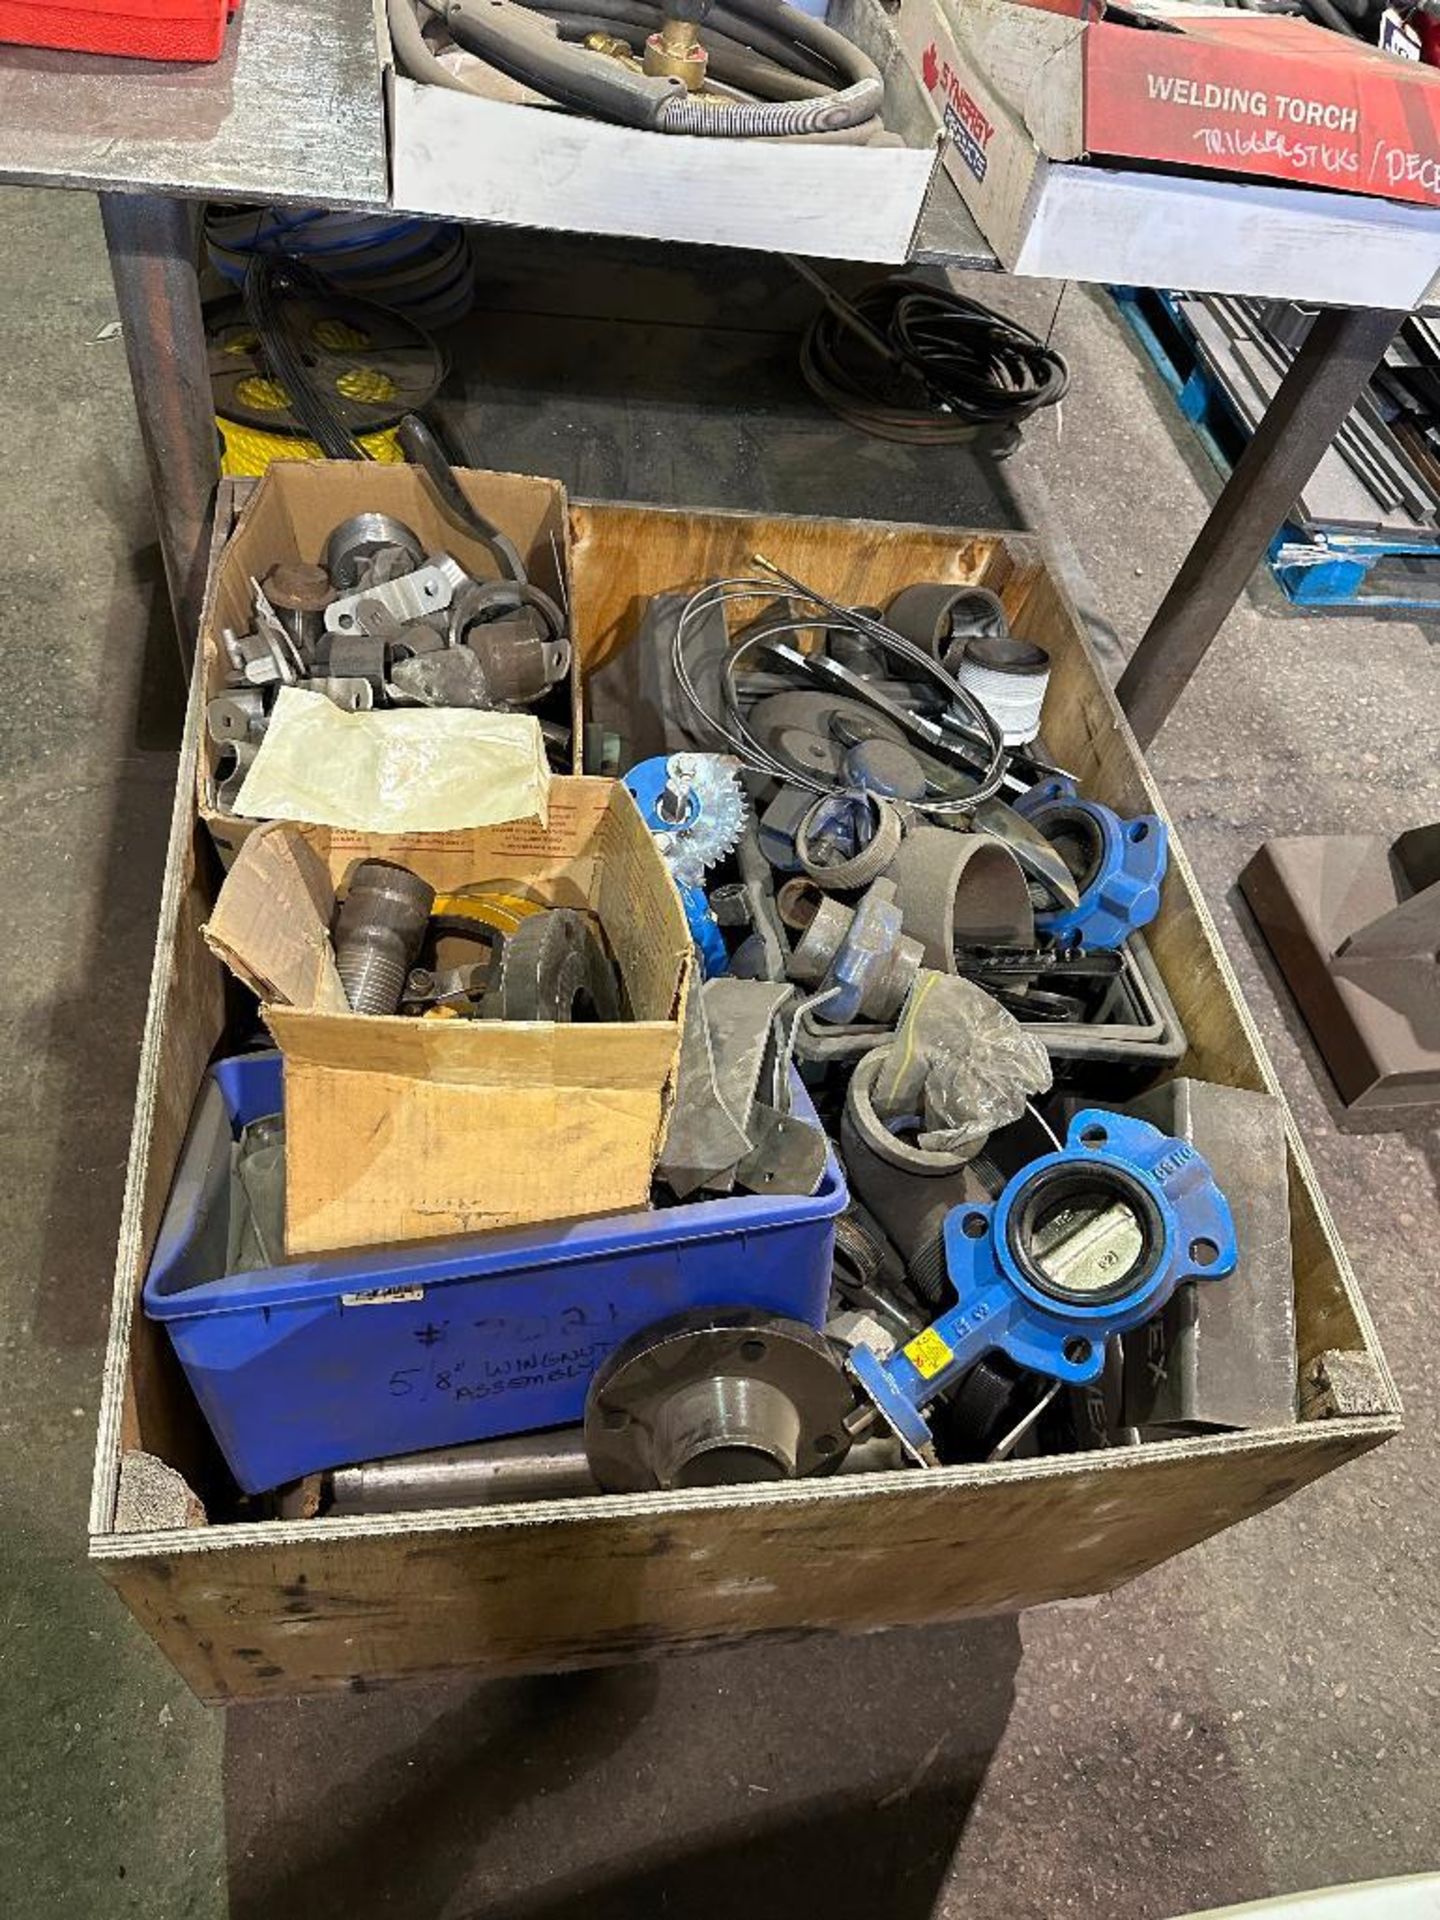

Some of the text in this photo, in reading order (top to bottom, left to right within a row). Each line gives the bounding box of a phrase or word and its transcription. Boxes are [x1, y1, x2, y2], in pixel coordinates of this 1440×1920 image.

[940, 61, 995, 150] SYNERGY
[1147, 74, 1359, 134] WELDING TORCH
